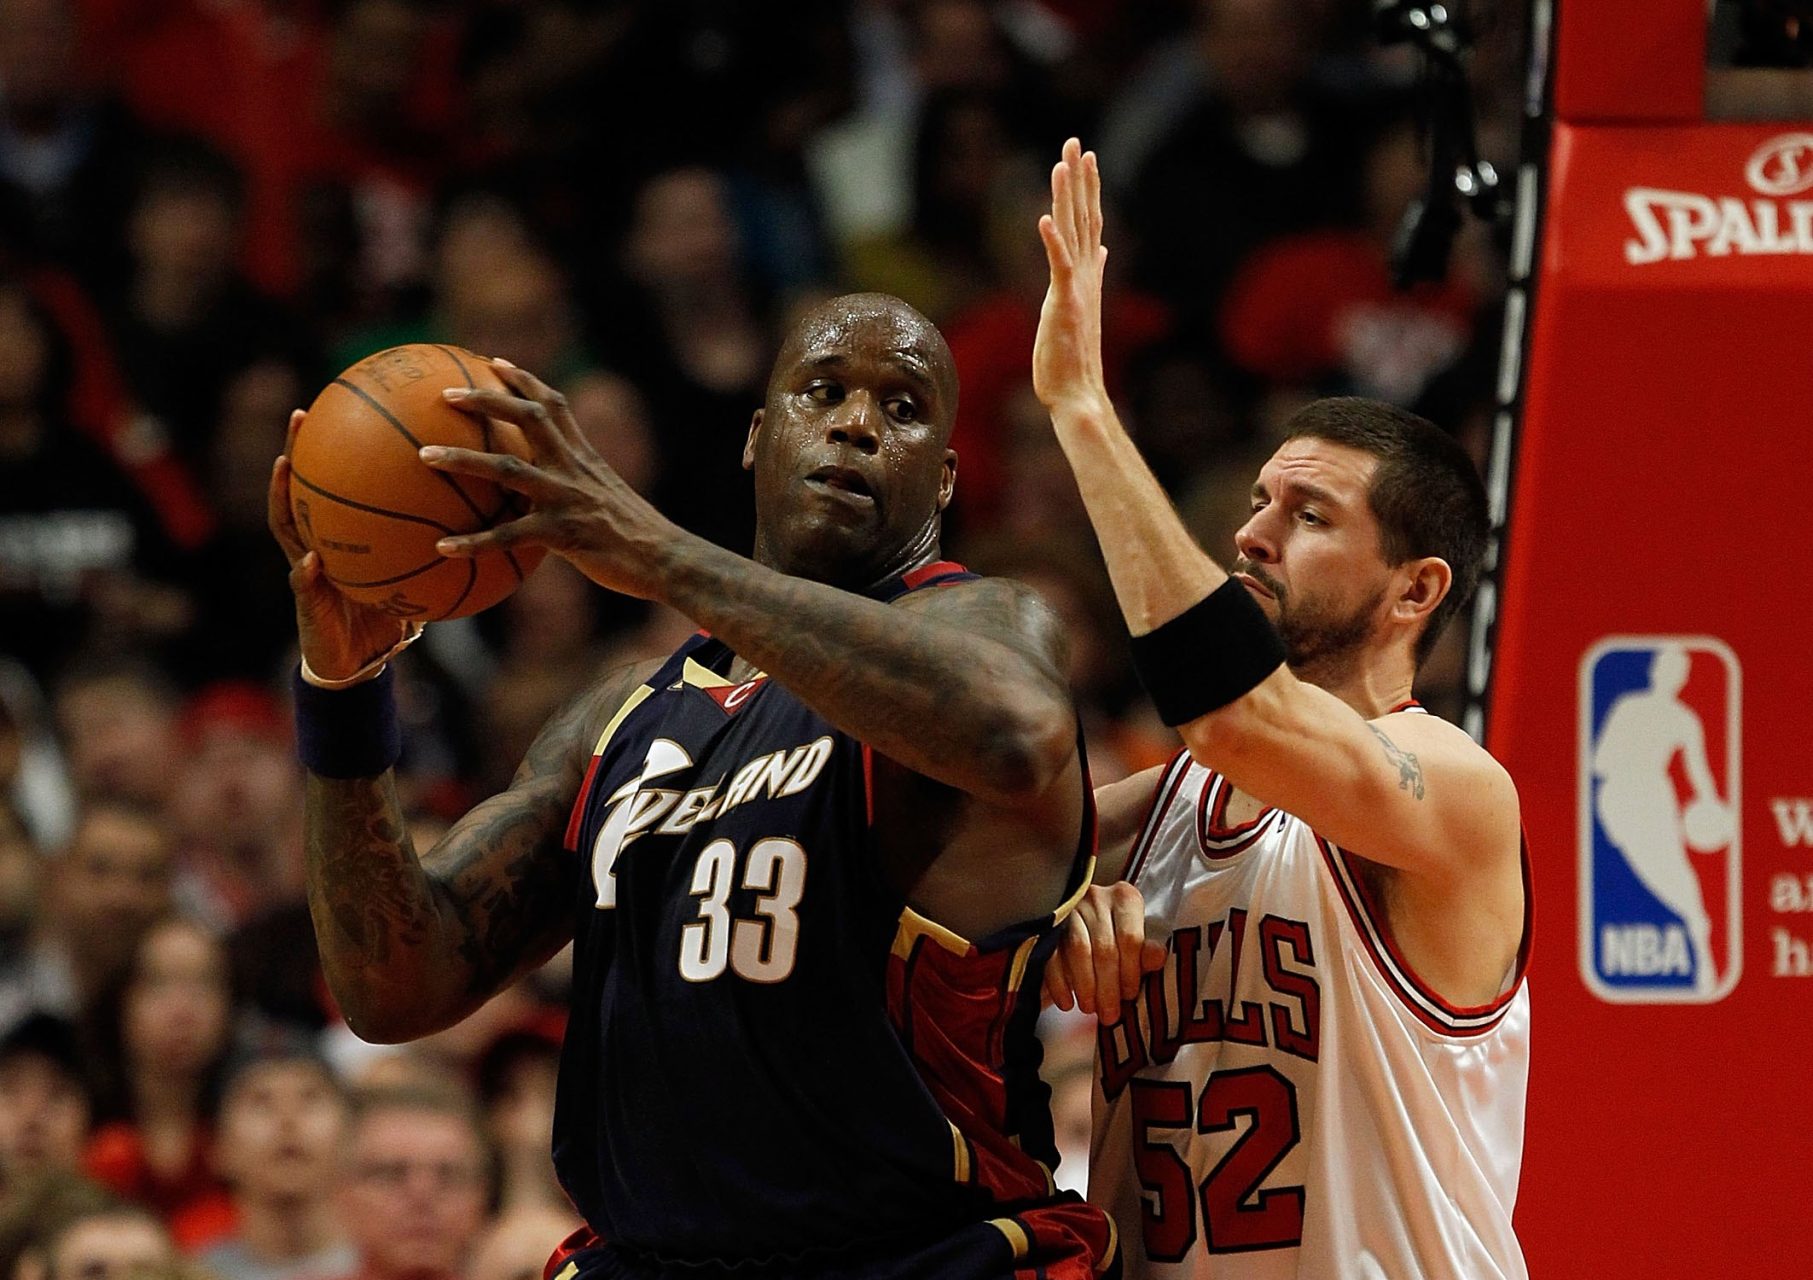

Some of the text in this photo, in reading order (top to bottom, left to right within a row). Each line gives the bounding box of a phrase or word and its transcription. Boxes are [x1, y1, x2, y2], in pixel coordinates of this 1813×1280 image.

[679, 837, 808, 983] 33
[1603, 926, 1692, 977] NBA
[1129, 1064, 1306, 1263] 52
